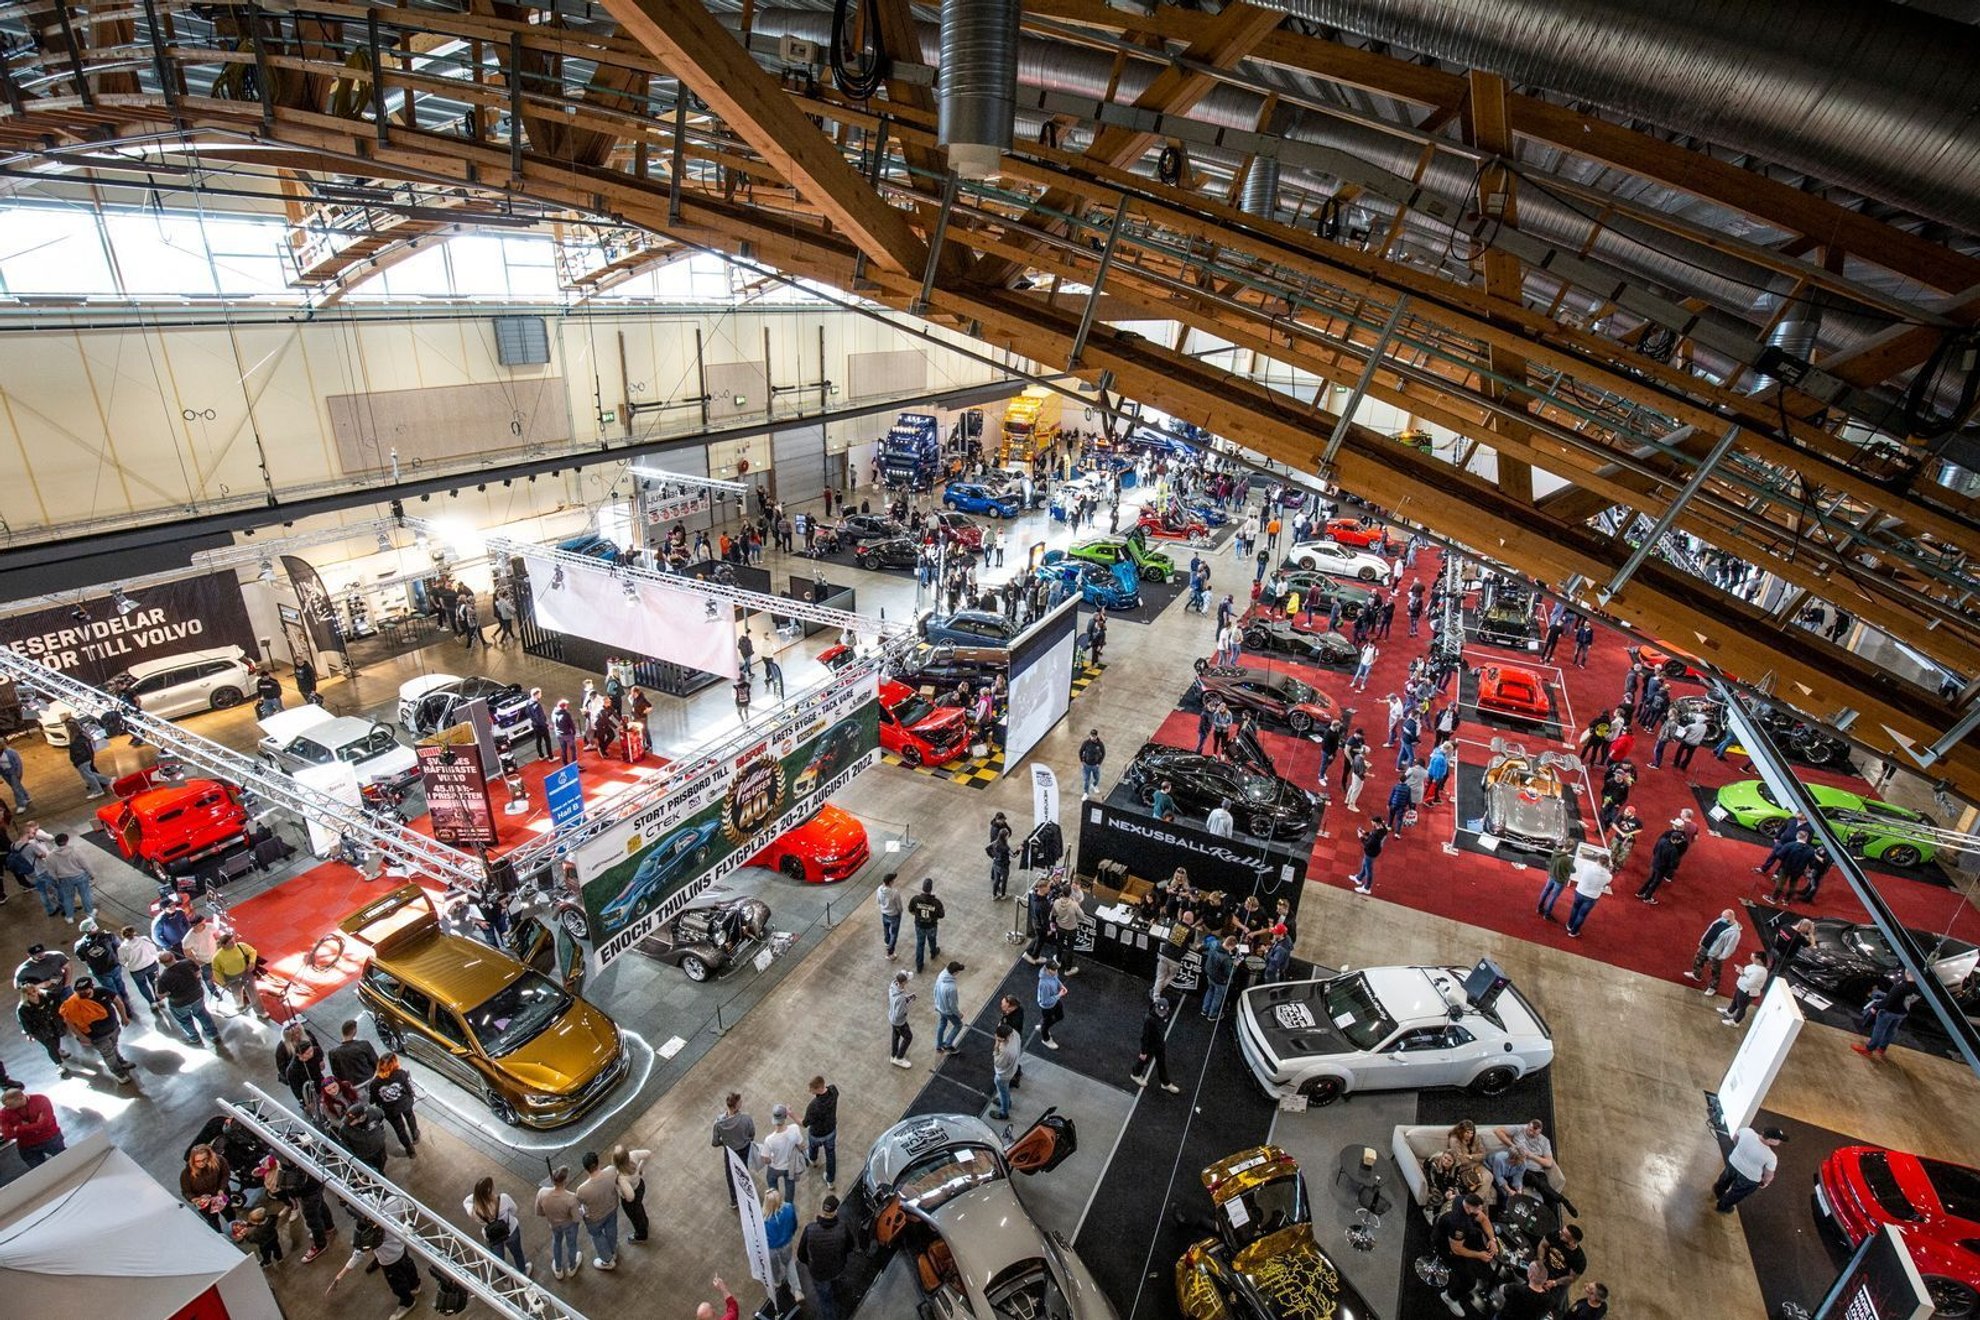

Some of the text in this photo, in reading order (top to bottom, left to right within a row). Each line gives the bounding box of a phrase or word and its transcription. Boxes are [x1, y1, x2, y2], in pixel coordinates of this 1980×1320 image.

[81, 638, 134, 662] TILL
[132, 618, 203, 649] VOLVO
[771, 724, 794, 746] ÅRETS
[821, 698, 838, 715] TACK
[633, 805, 665, 831] STORT
[668, 776, 711, 811] PRISBORD
[712, 766, 730, 785] TILL
[738, 791, 769, 828] 40
[645, 809, 681, 839] CTEK
[601, 753, 873, 966] ENOCH THULINS FLYGPLATS 20-21 AUGUSTI 2022
